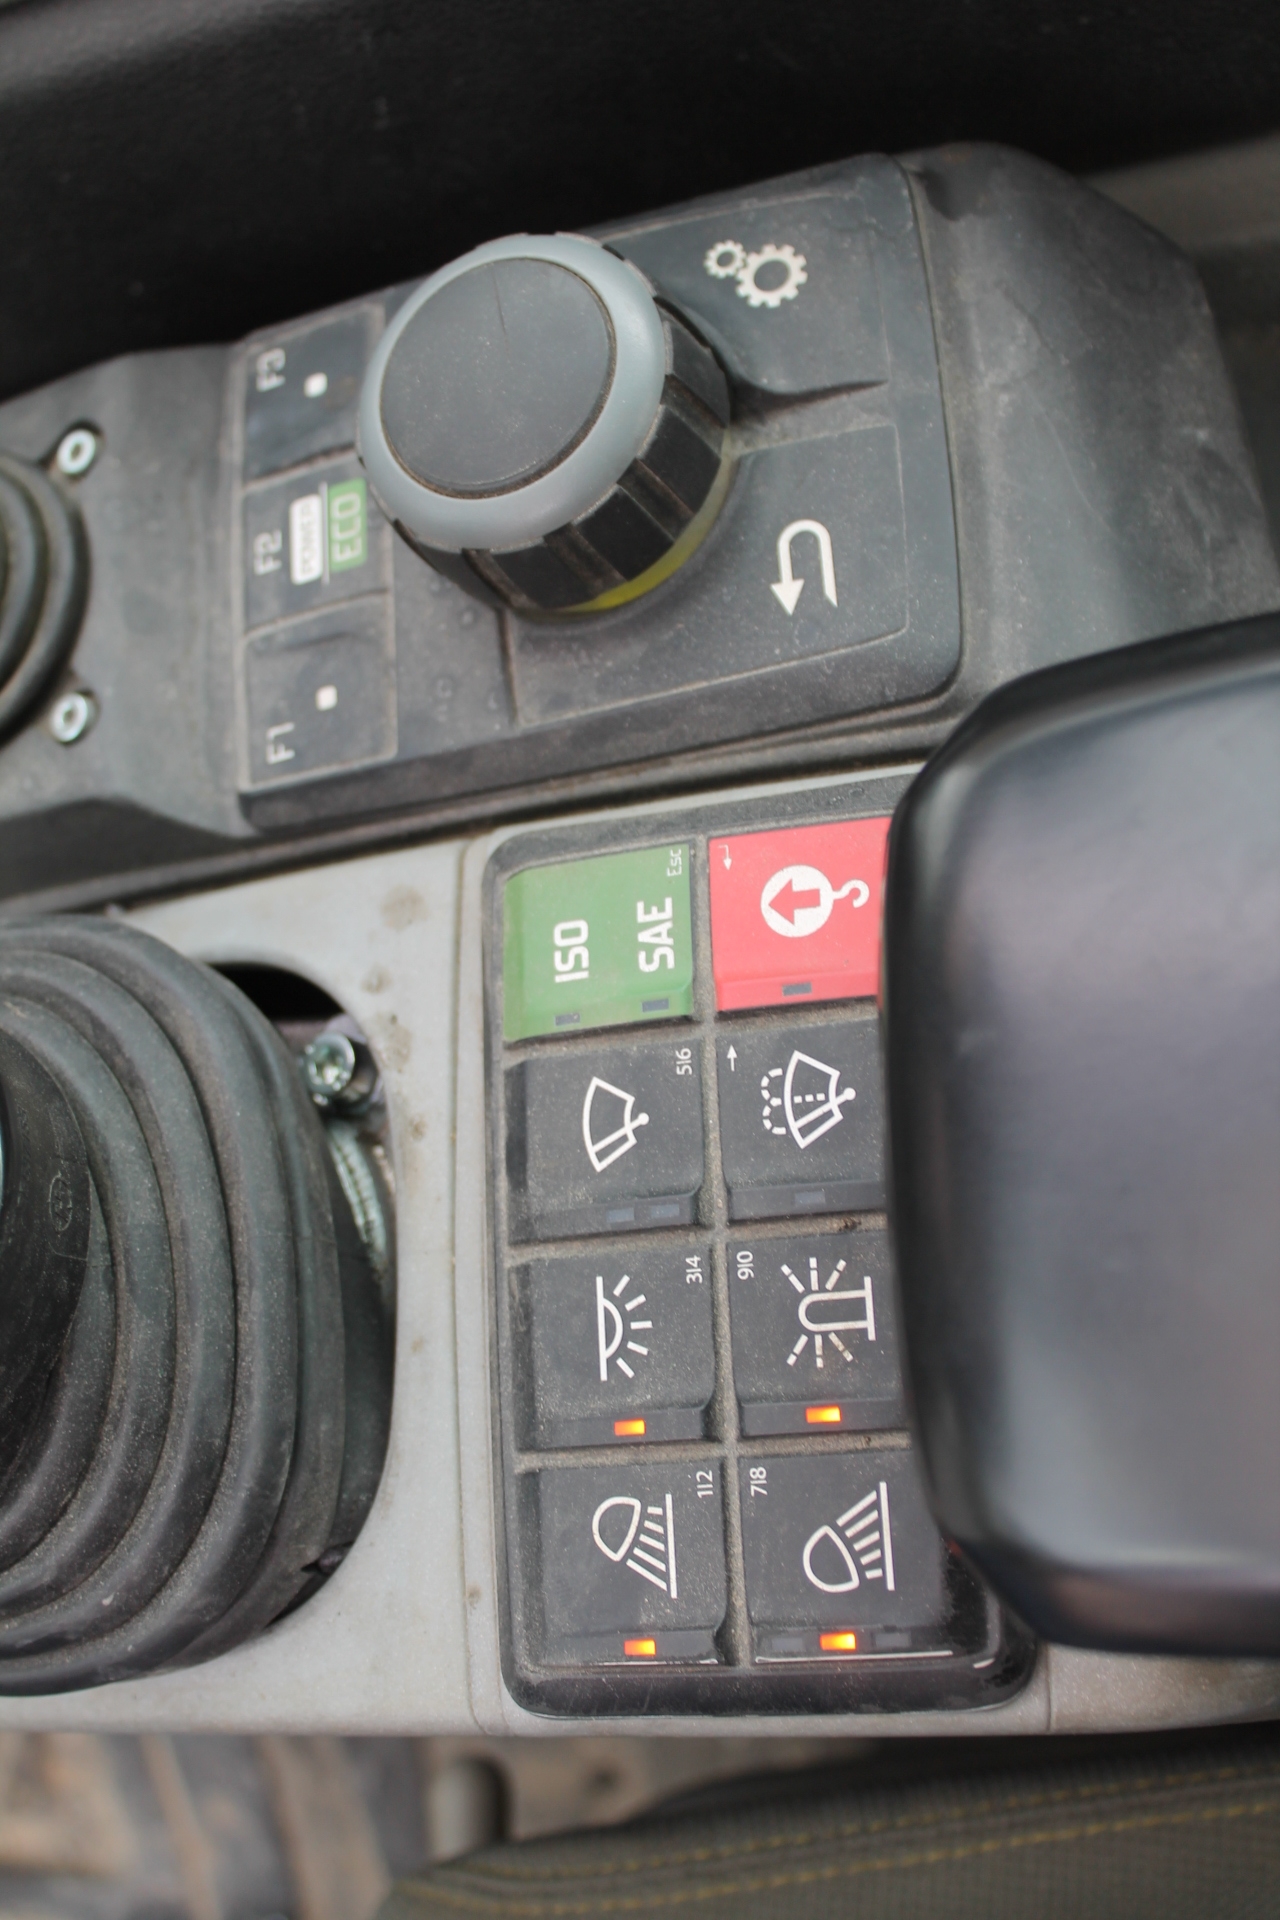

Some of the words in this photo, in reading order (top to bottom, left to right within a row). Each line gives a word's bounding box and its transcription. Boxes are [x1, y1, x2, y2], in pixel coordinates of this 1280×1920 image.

[256, 347, 286, 392] F3
[332, 492, 361, 563] ECO
[254, 529, 282, 576] F2
[266, 721, 296, 765] F1
[666, 848, 682, 877] Esc
[553, 918, 590, 984] ISO
[637, 896, 676, 973] SAE
